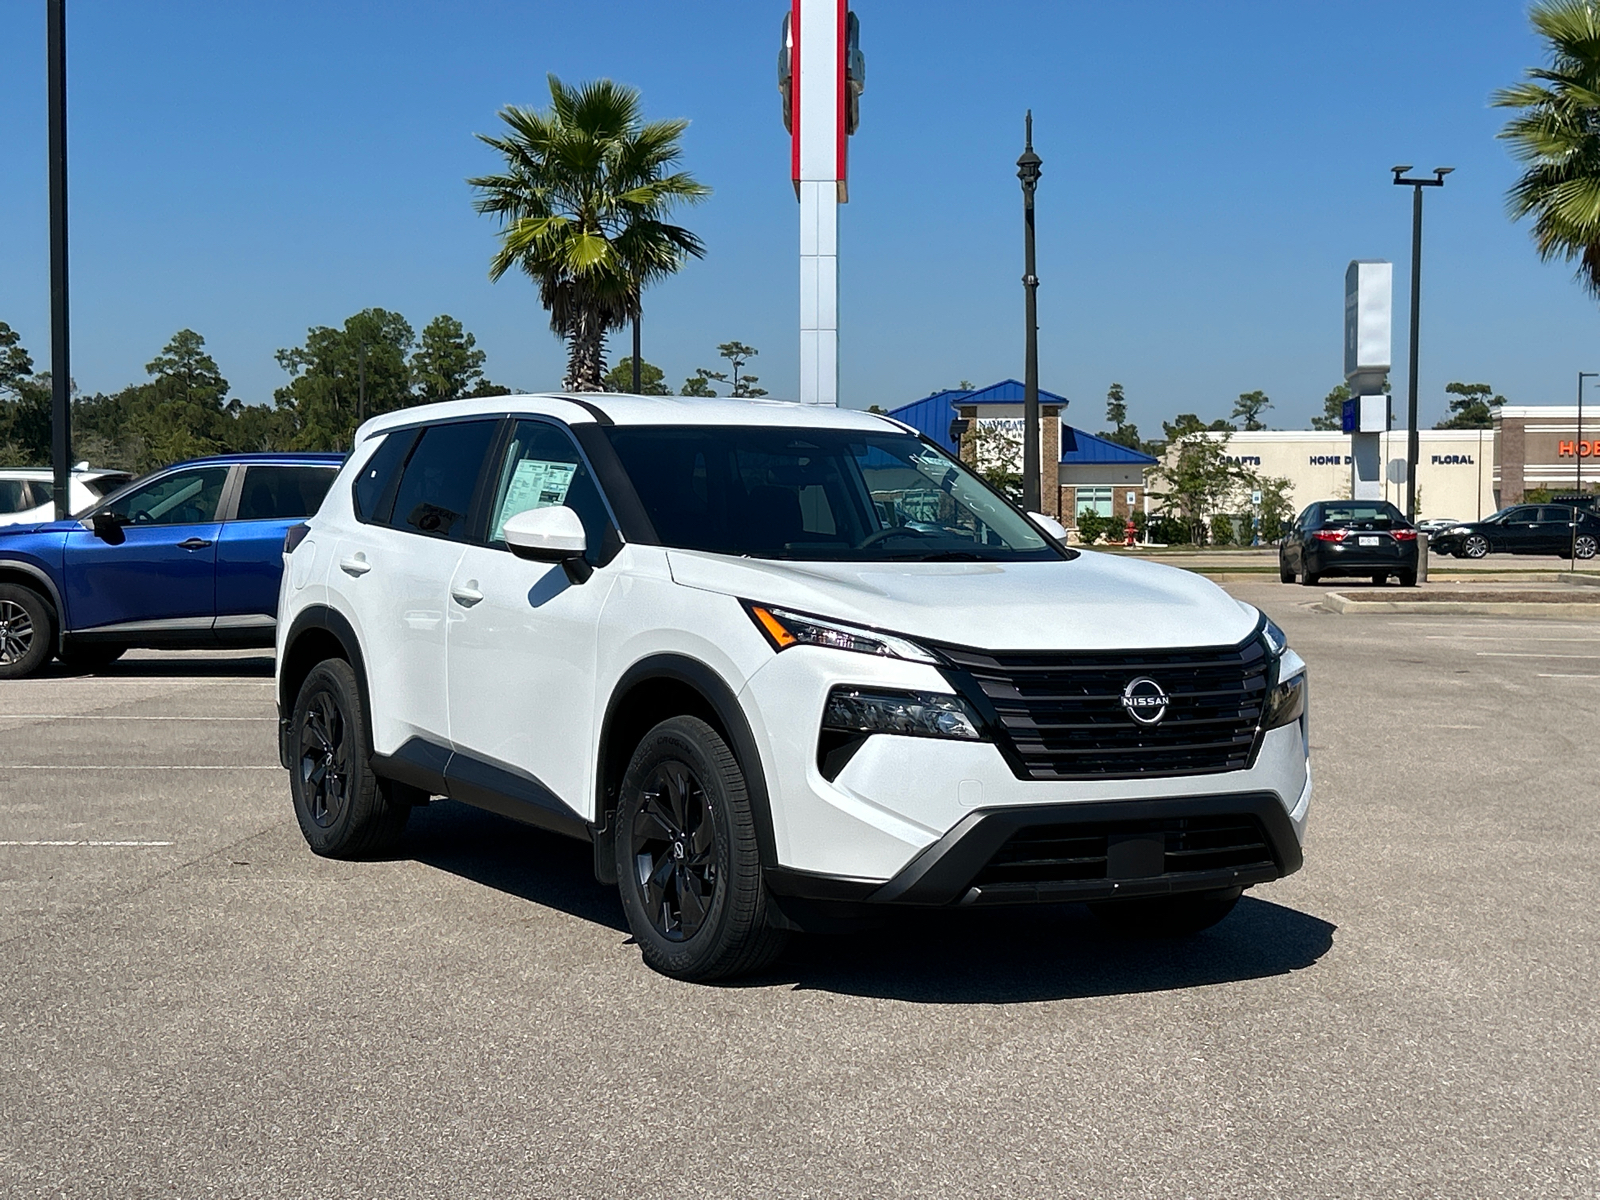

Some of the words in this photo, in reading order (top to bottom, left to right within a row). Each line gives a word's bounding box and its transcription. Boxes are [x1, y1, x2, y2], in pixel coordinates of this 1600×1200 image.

[978, 420, 1040, 431] NAVIGAT
[1219, 456, 1261, 466] CRAFTS
[1309, 455, 1341, 466] HOME
[1431, 454, 1475, 465] FLORAL
[1123, 697, 1169, 706] NISSAN
